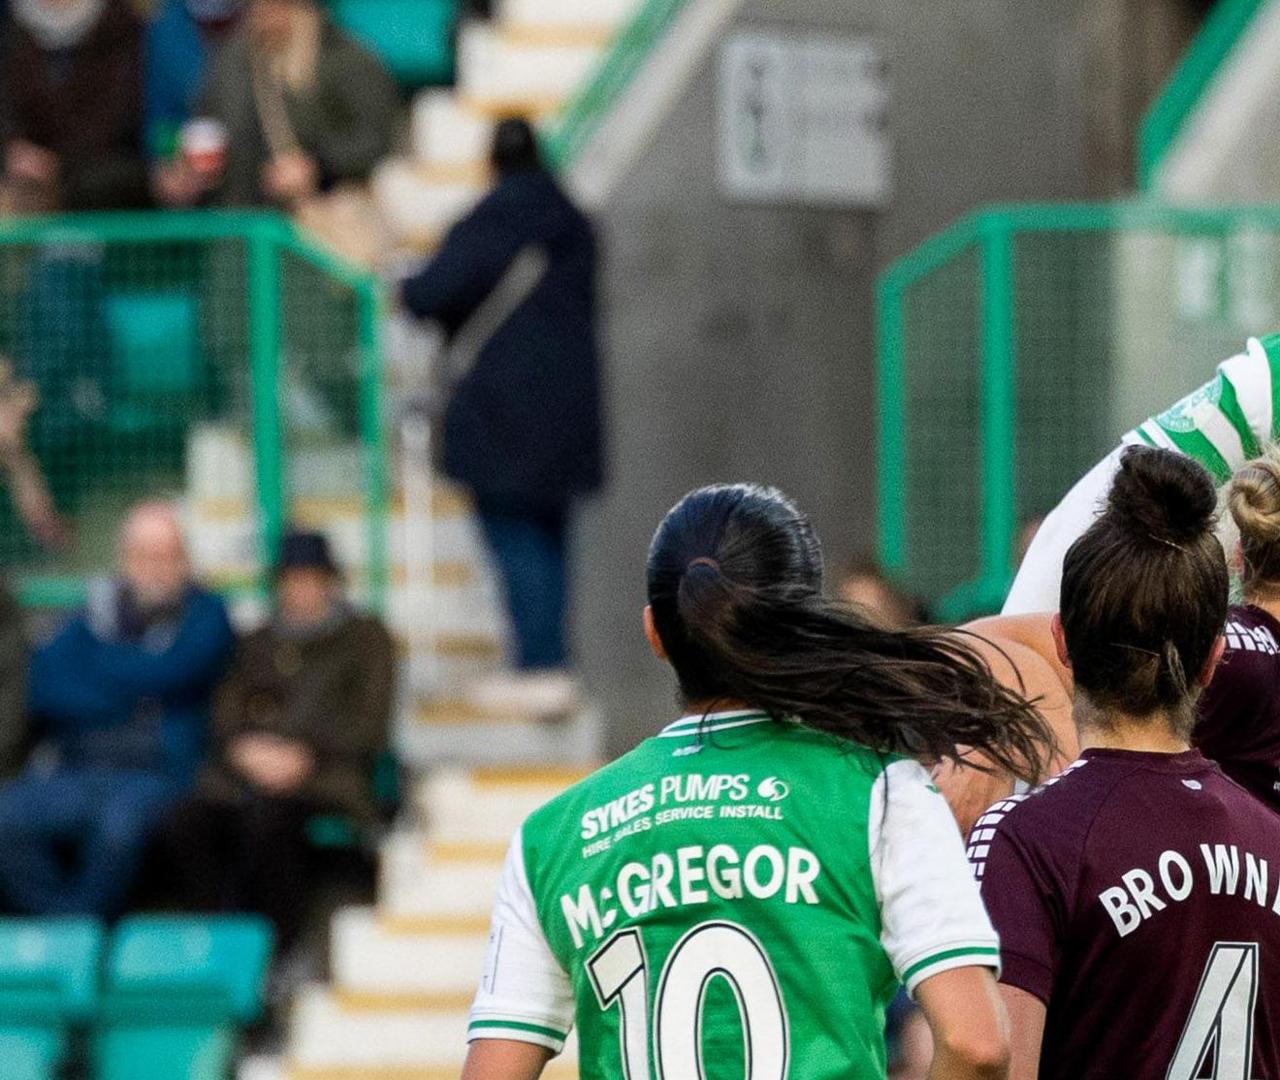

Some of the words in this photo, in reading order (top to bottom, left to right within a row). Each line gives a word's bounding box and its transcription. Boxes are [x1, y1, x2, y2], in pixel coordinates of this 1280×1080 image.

[581, 784, 655, 840] SYKES
[660, 774, 749, 805] PUMPS
[582, 837, 612, 858] HIRE
[655, 807, 714, 825] SERVICE
[719, 805, 783, 820] INSTALL
